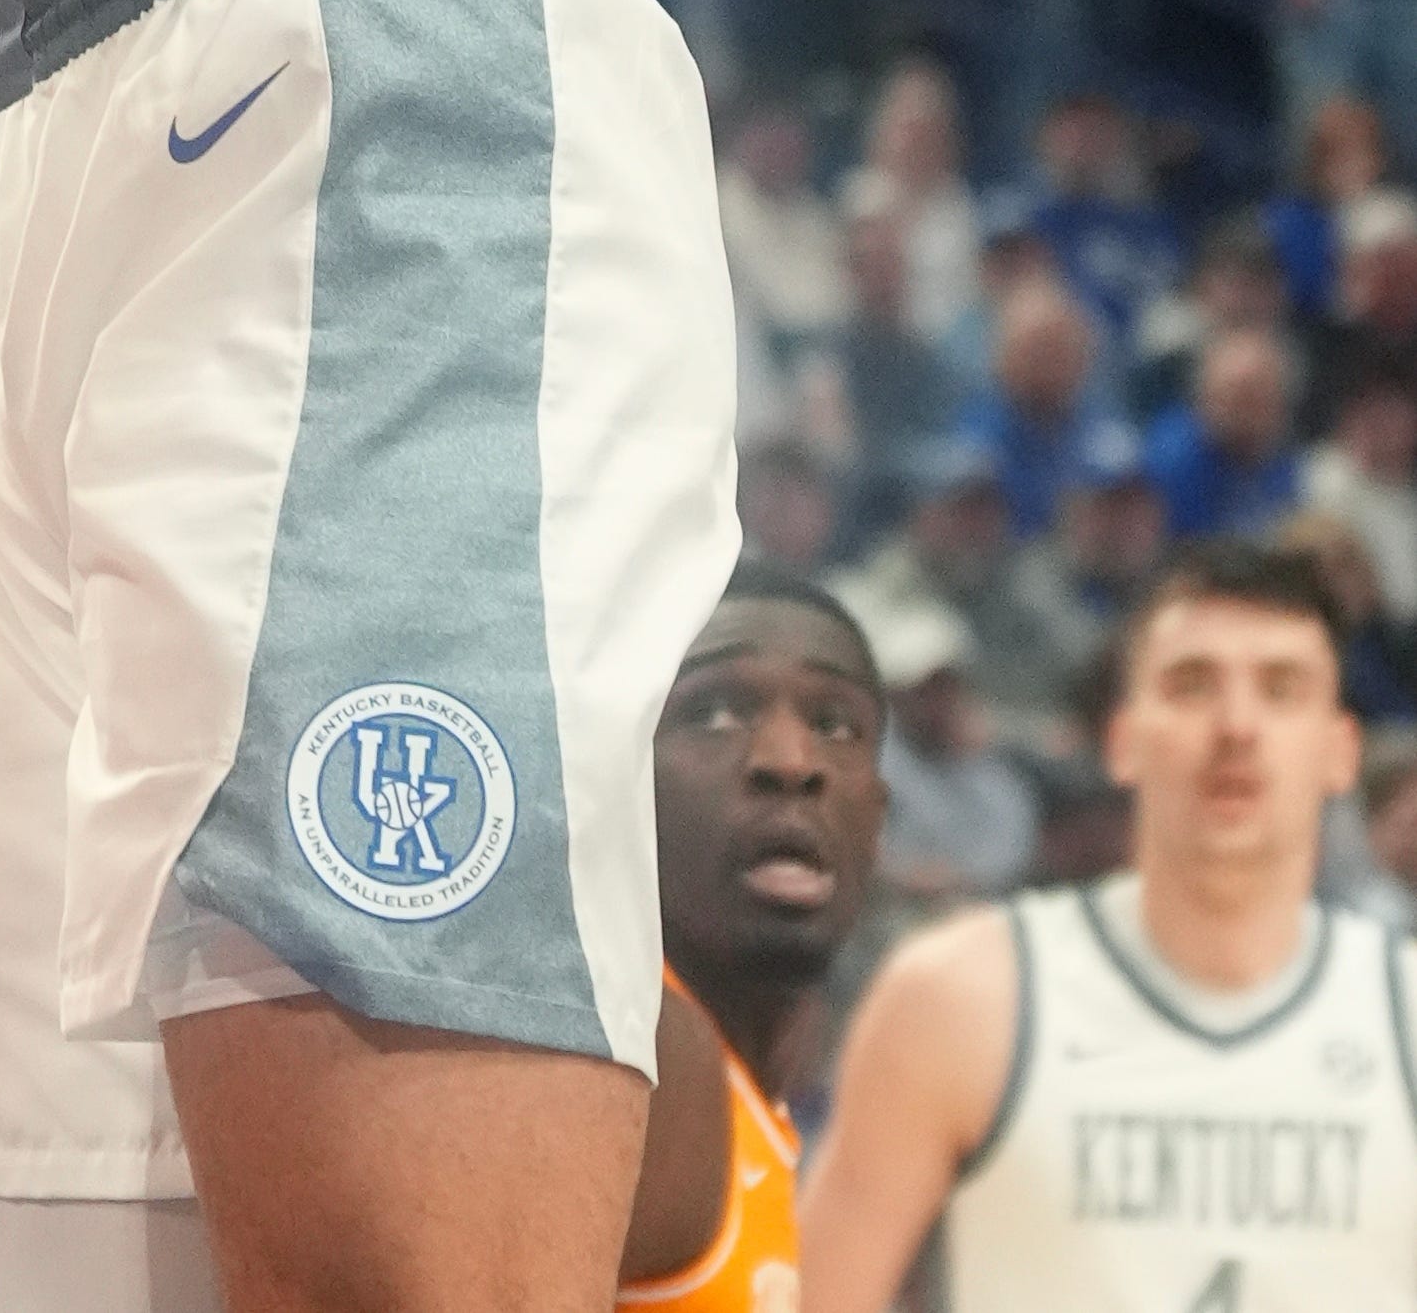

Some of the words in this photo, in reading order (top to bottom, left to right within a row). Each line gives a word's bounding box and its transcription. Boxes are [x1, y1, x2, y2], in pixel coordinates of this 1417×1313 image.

[307, 692, 393, 757] KENTUCKY
[399, 693, 500, 779] BASKETBALL
[297, 793, 312, 821] AN
[305, 828, 435, 909] UNPARALLELED
[438, 815, 504, 902] TRADITION
[1070, 1113, 1368, 1232] KENTUCKY
